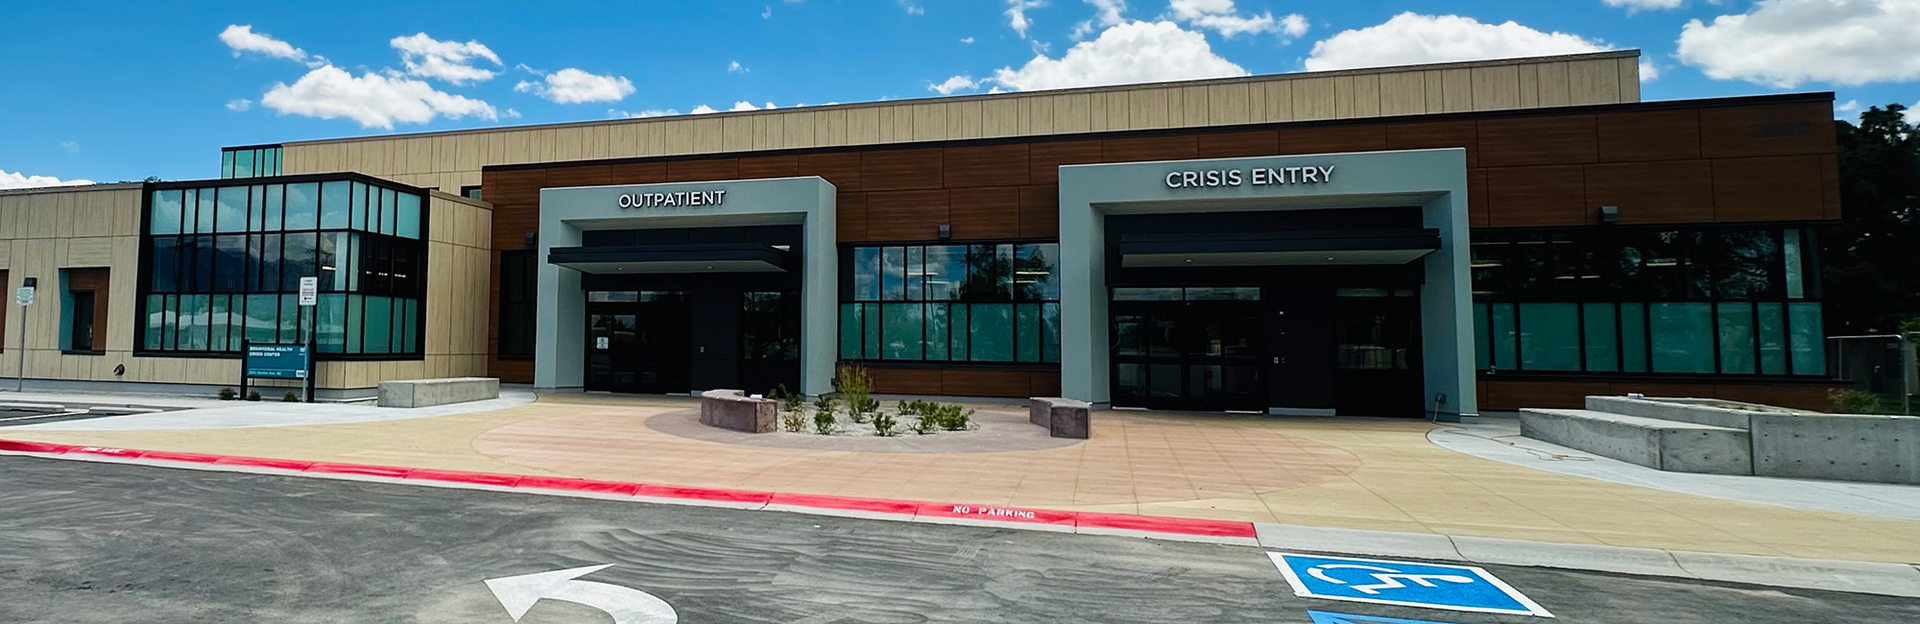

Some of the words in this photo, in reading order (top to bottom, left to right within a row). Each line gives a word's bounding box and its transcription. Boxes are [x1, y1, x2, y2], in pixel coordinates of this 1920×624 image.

[1166, 169, 1242, 188] CRISIS
[1252, 165, 1335, 185] ENTRY
[619, 190, 725, 208] OUTPATIENT
[953, 505, 970, 514] NO
[978, 507, 1035, 519] PARKING
